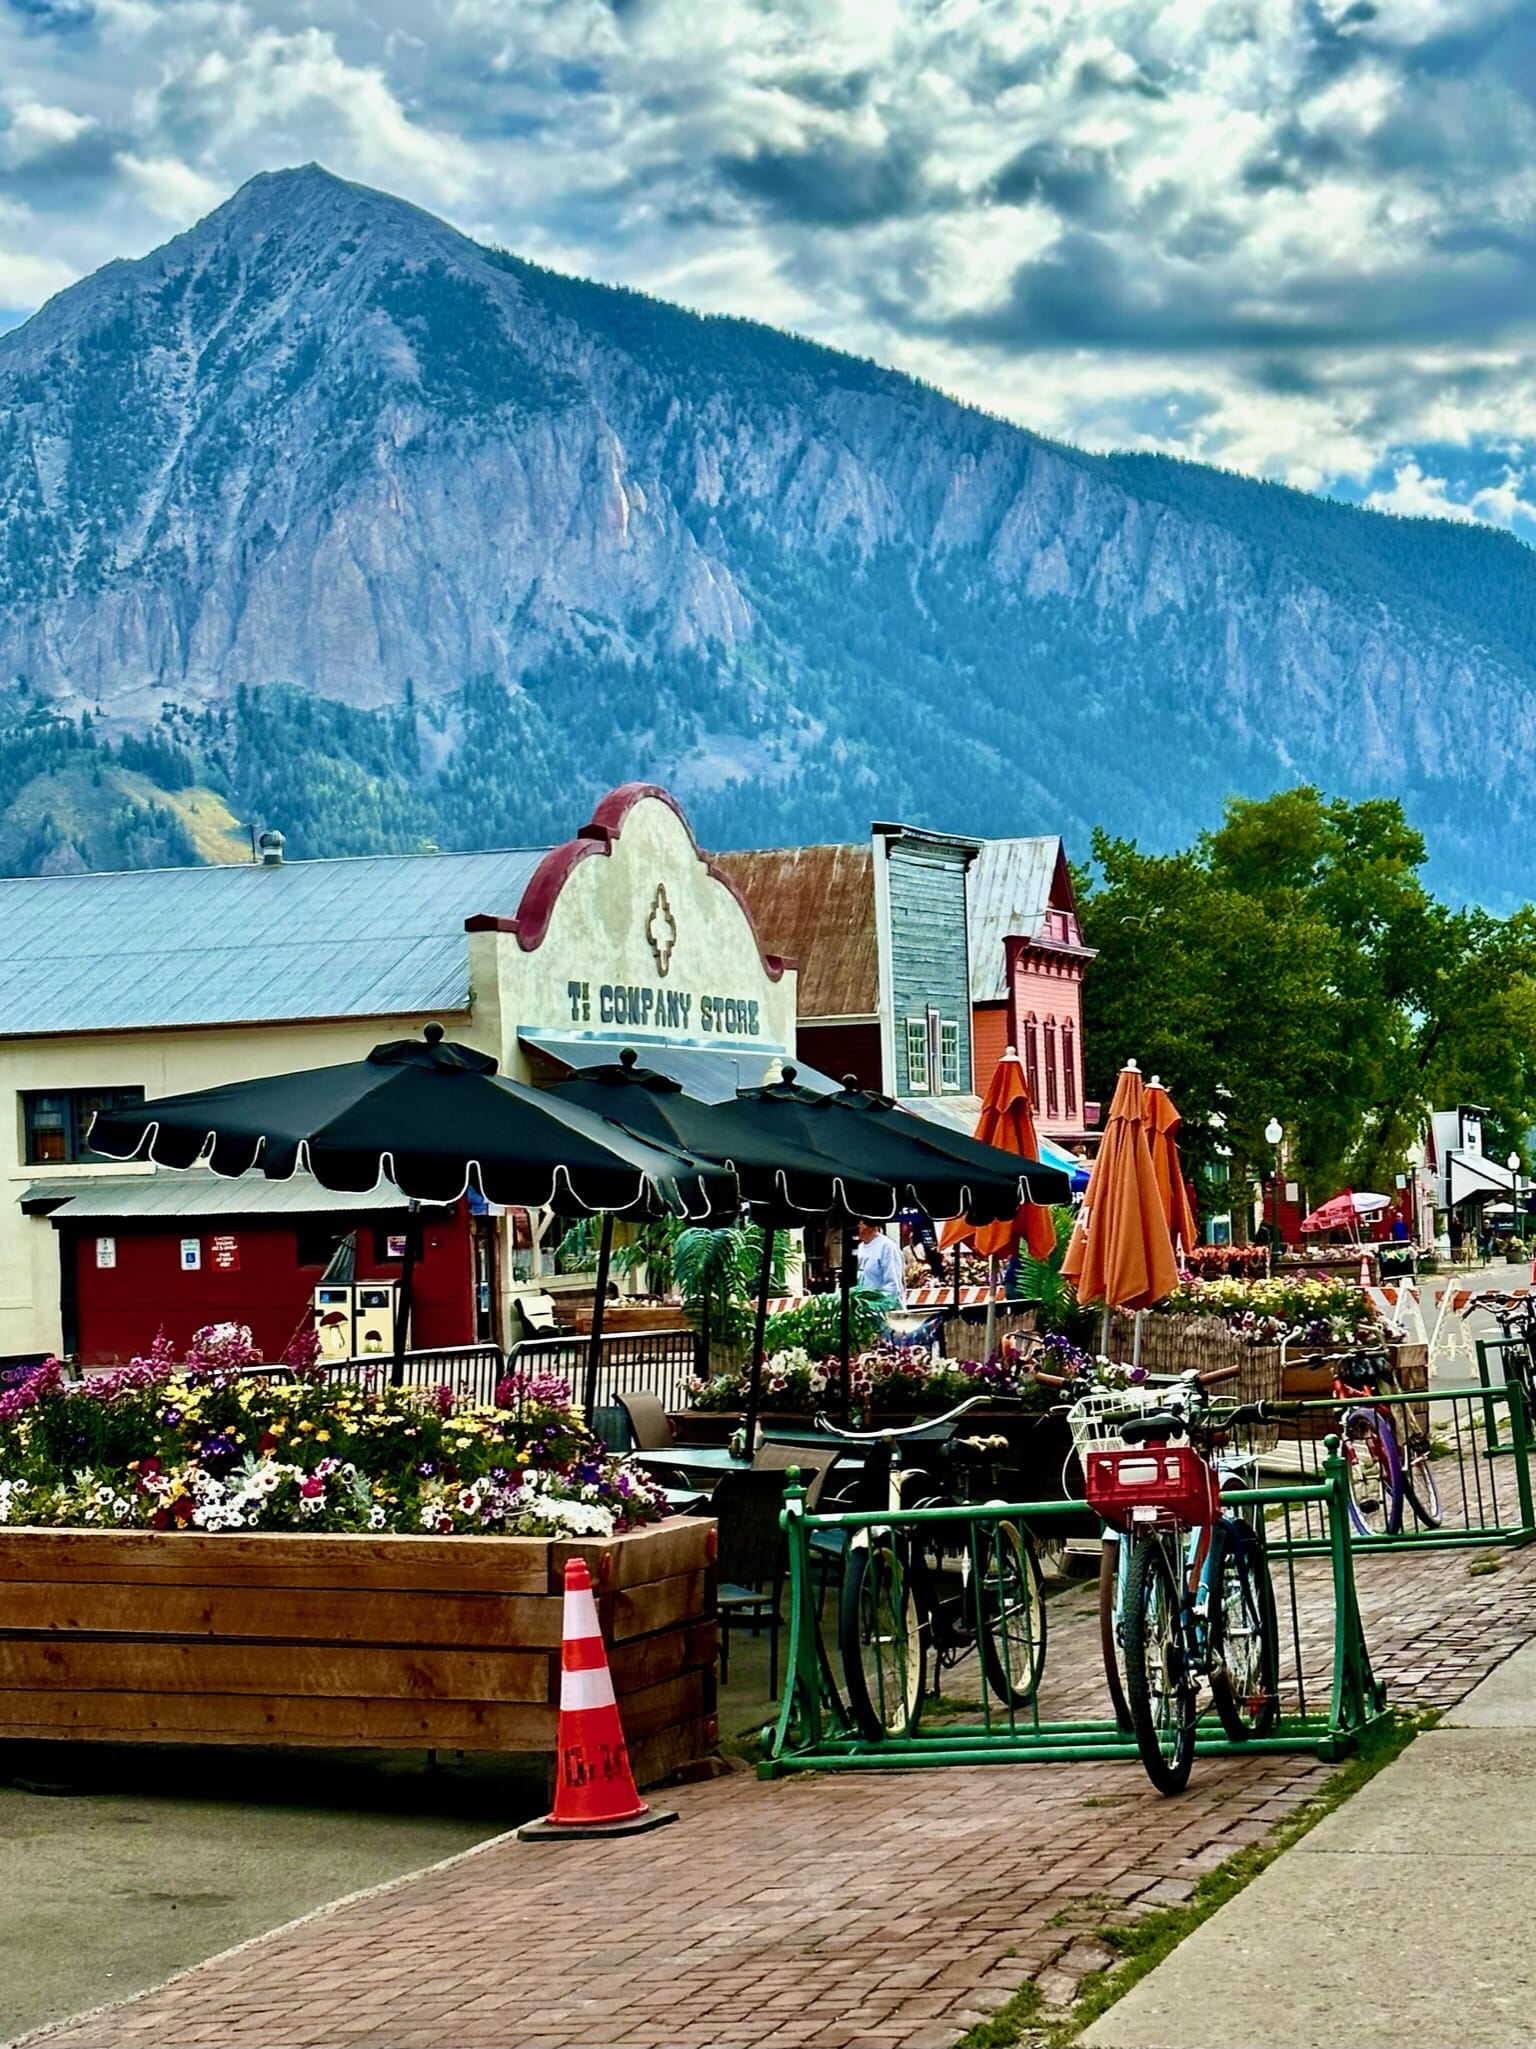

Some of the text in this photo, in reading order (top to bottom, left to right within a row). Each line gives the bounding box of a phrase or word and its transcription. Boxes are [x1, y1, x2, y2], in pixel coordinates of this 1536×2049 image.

[567, 981, 760, 1036] THE COMPANY STORE
